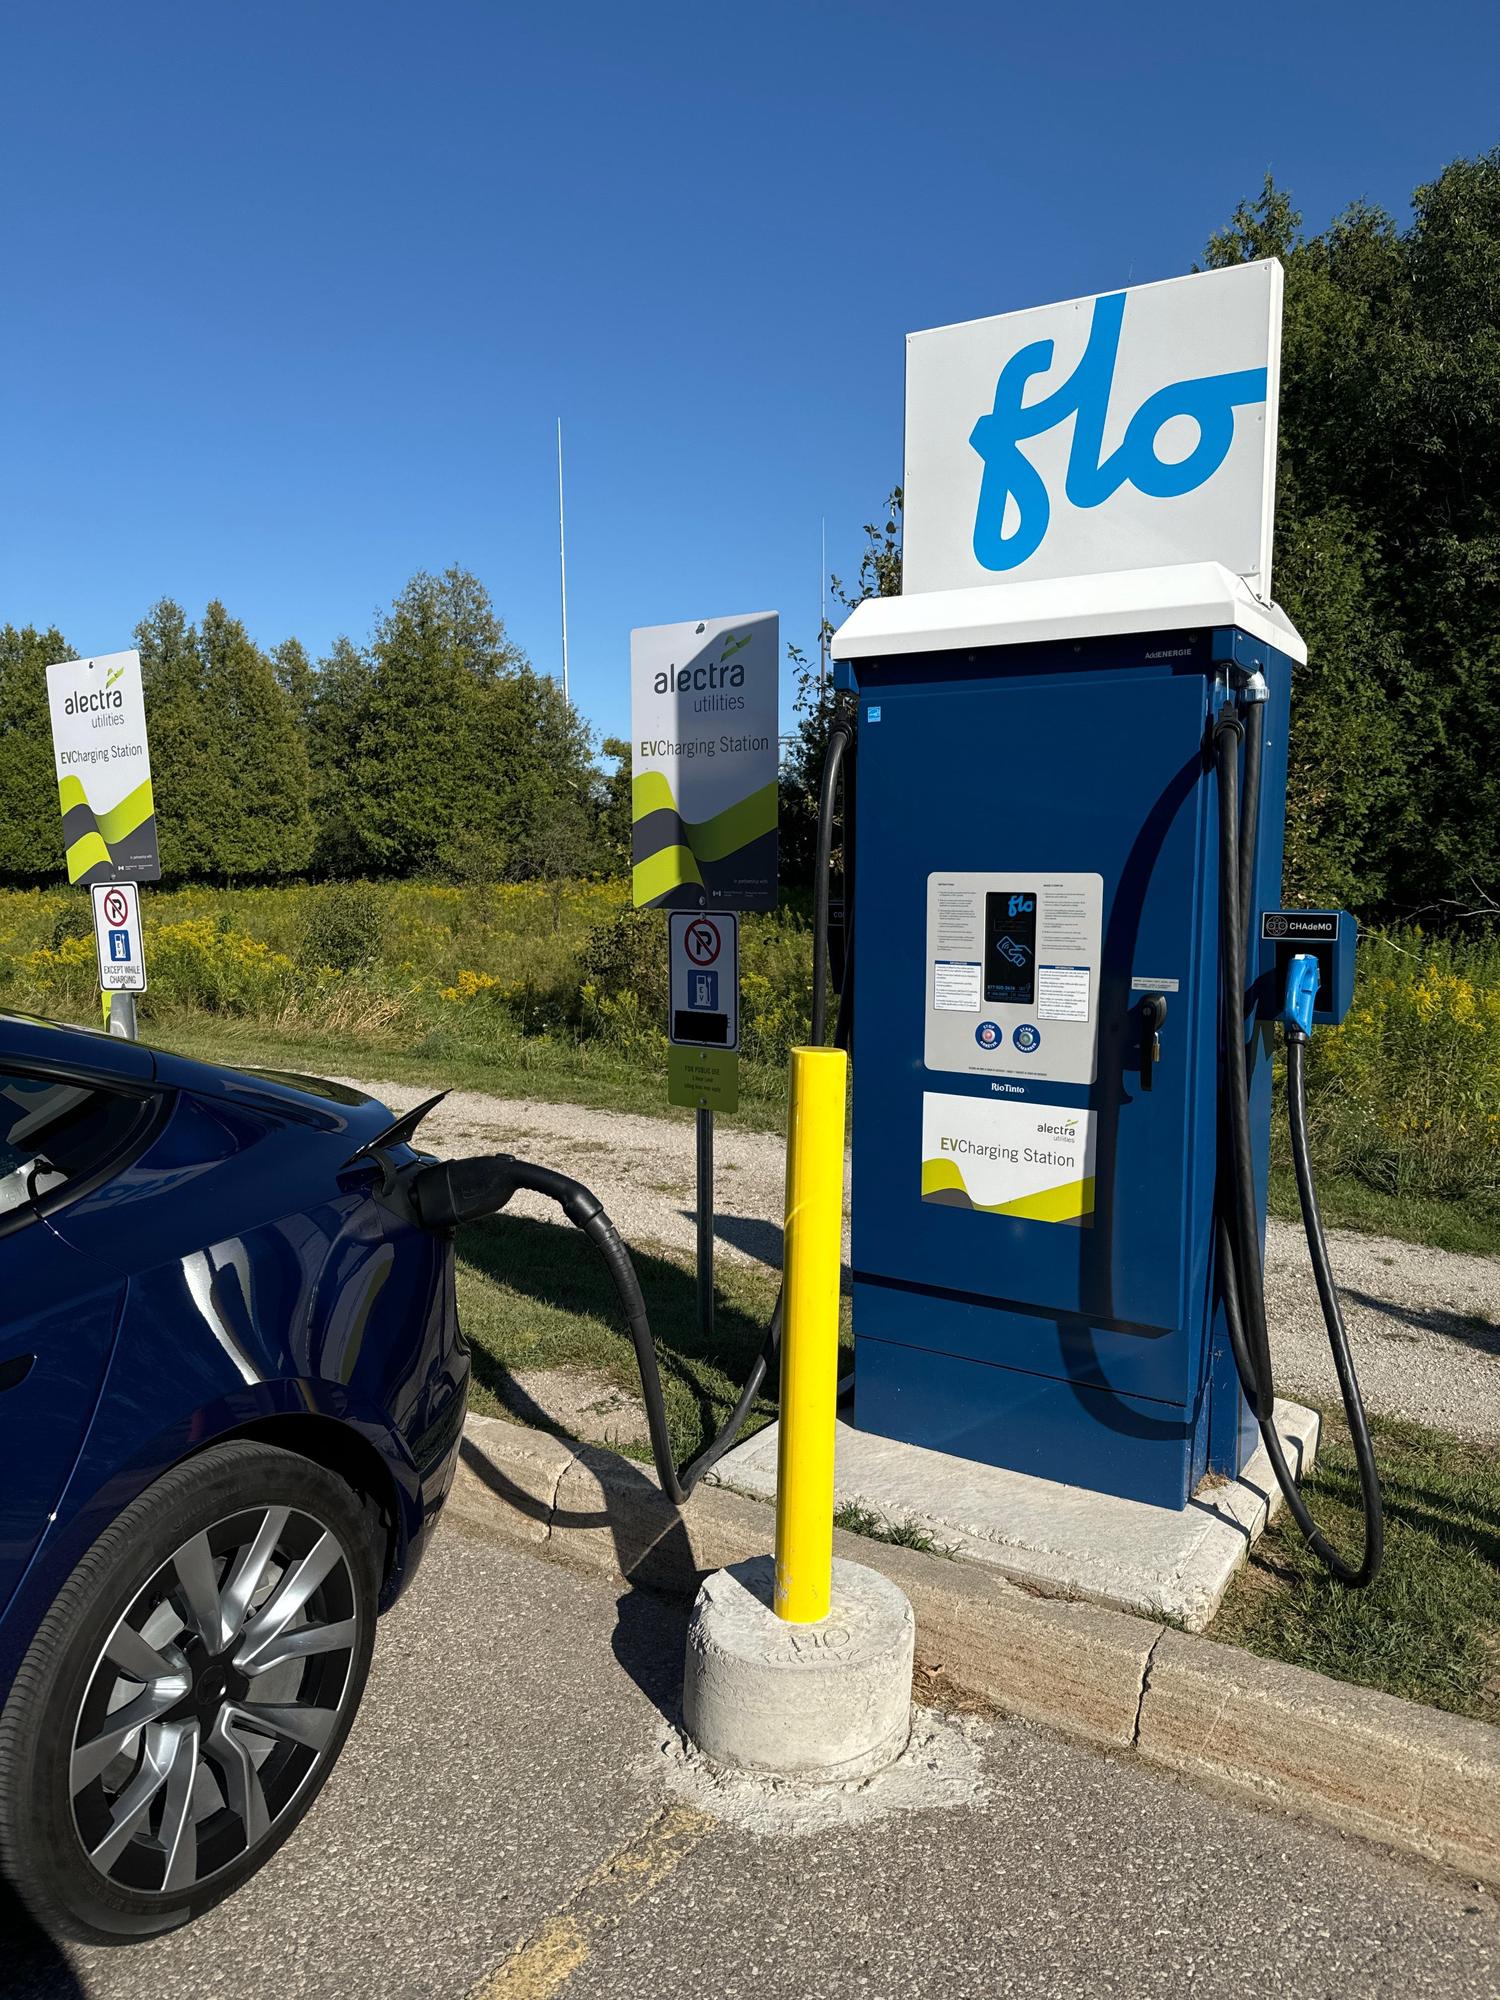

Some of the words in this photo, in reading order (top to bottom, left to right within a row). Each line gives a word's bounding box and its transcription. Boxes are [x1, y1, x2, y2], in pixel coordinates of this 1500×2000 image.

[969, 291, 1267, 572] flo
[653, 663, 745, 694] alectra
[64, 689, 123, 715] alectra
[694, 693, 745, 713] utilities
[91, 712, 125, 729] utilities
[111, 742, 143, 759] Station
[719, 735, 769, 753] Station
[1008, 895, 1034, 918] flo
[1289, 922, 1333, 931] CHAdeMO
[104, 965, 123, 975] EXCEPT
[124, 965, 141, 975] WHILE
[109, 975, 137, 984] CHARGING
[991, 1082, 1025, 1094] RioTinto
[1037, 1122, 1076, 1136] alectra
[1053, 1136, 1076, 1144] utilities
[1023, 1148, 1075, 1168] Station
